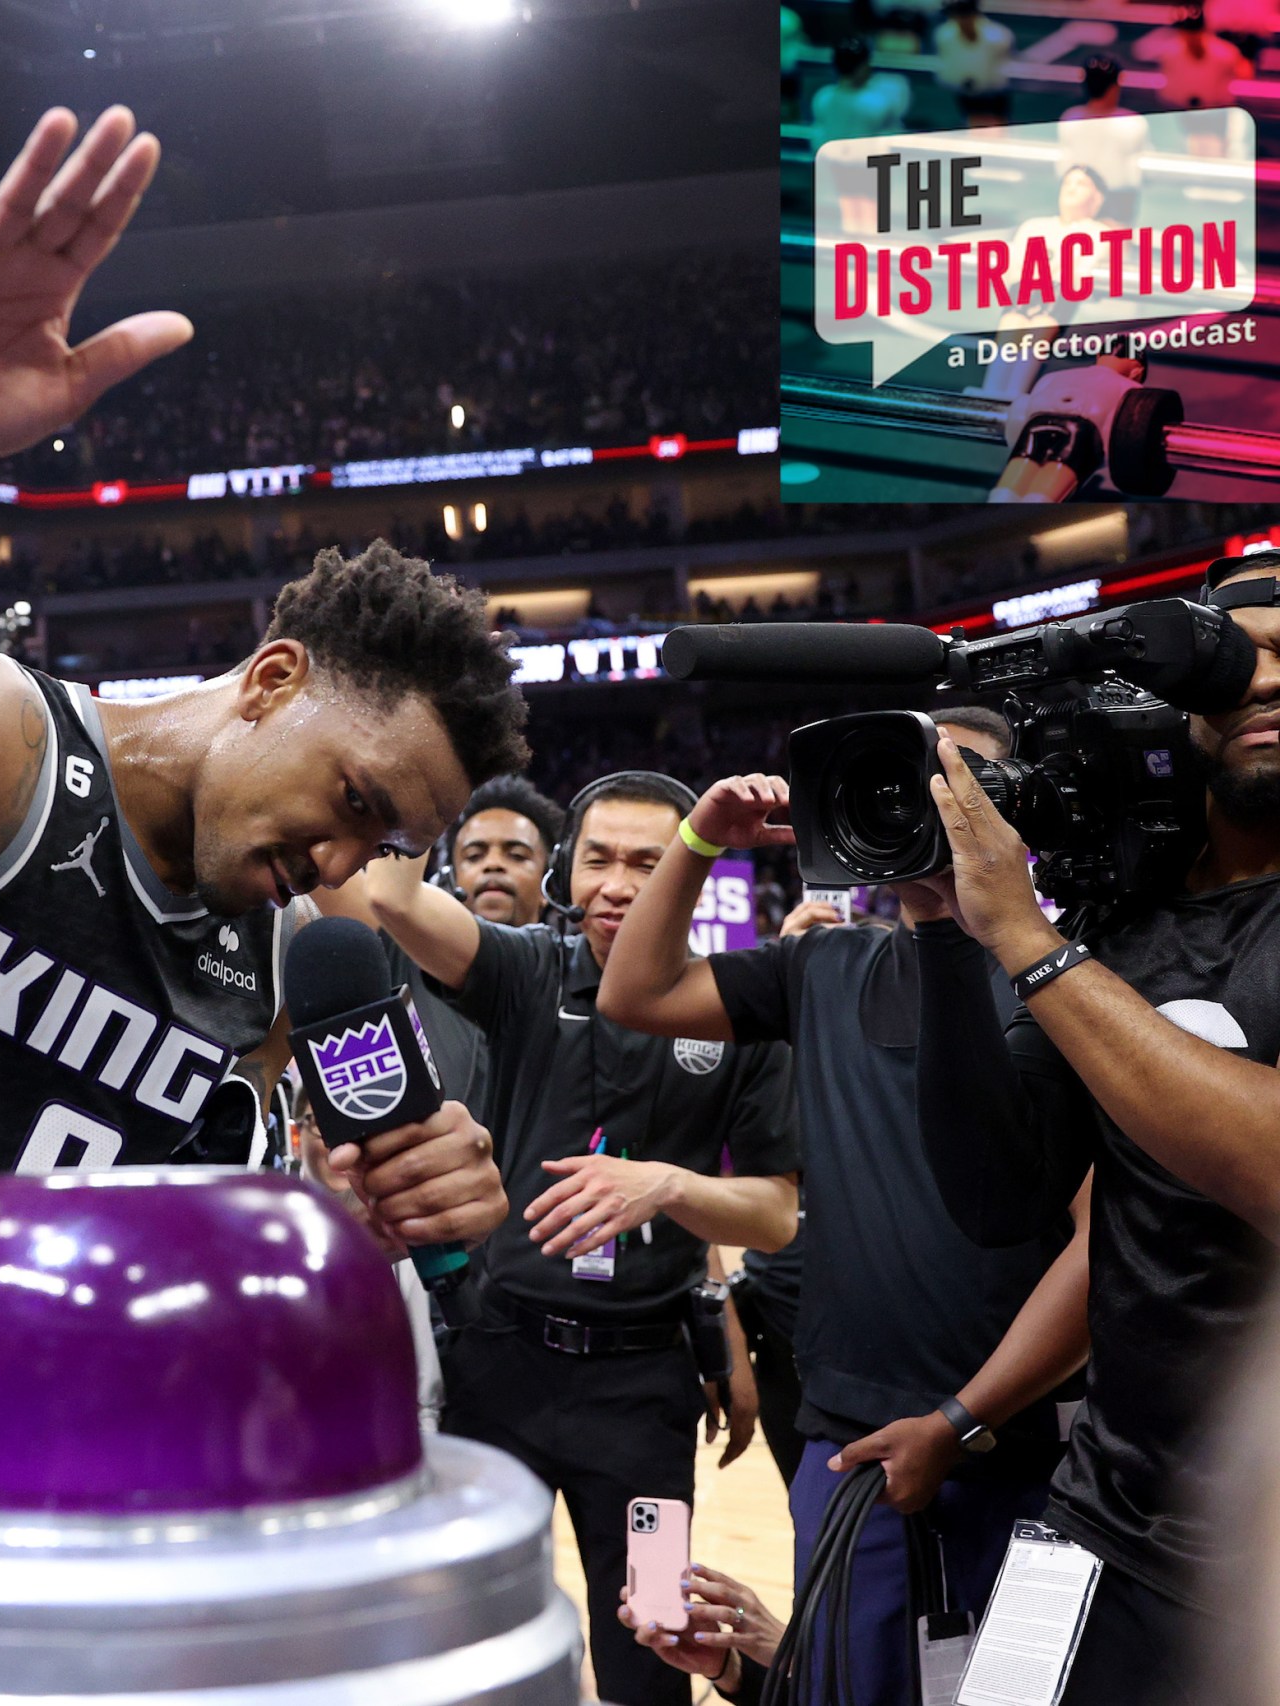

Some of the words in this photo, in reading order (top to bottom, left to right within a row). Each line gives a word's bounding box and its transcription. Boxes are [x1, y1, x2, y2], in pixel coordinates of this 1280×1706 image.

[967, 640, 997, 653] SONY
[64, 754, 95, 798] 6
[197, 951, 257, 992] dialpad
[1025, 963, 1054, 985] NIKE
[324, 1050, 401, 1091] SAC
